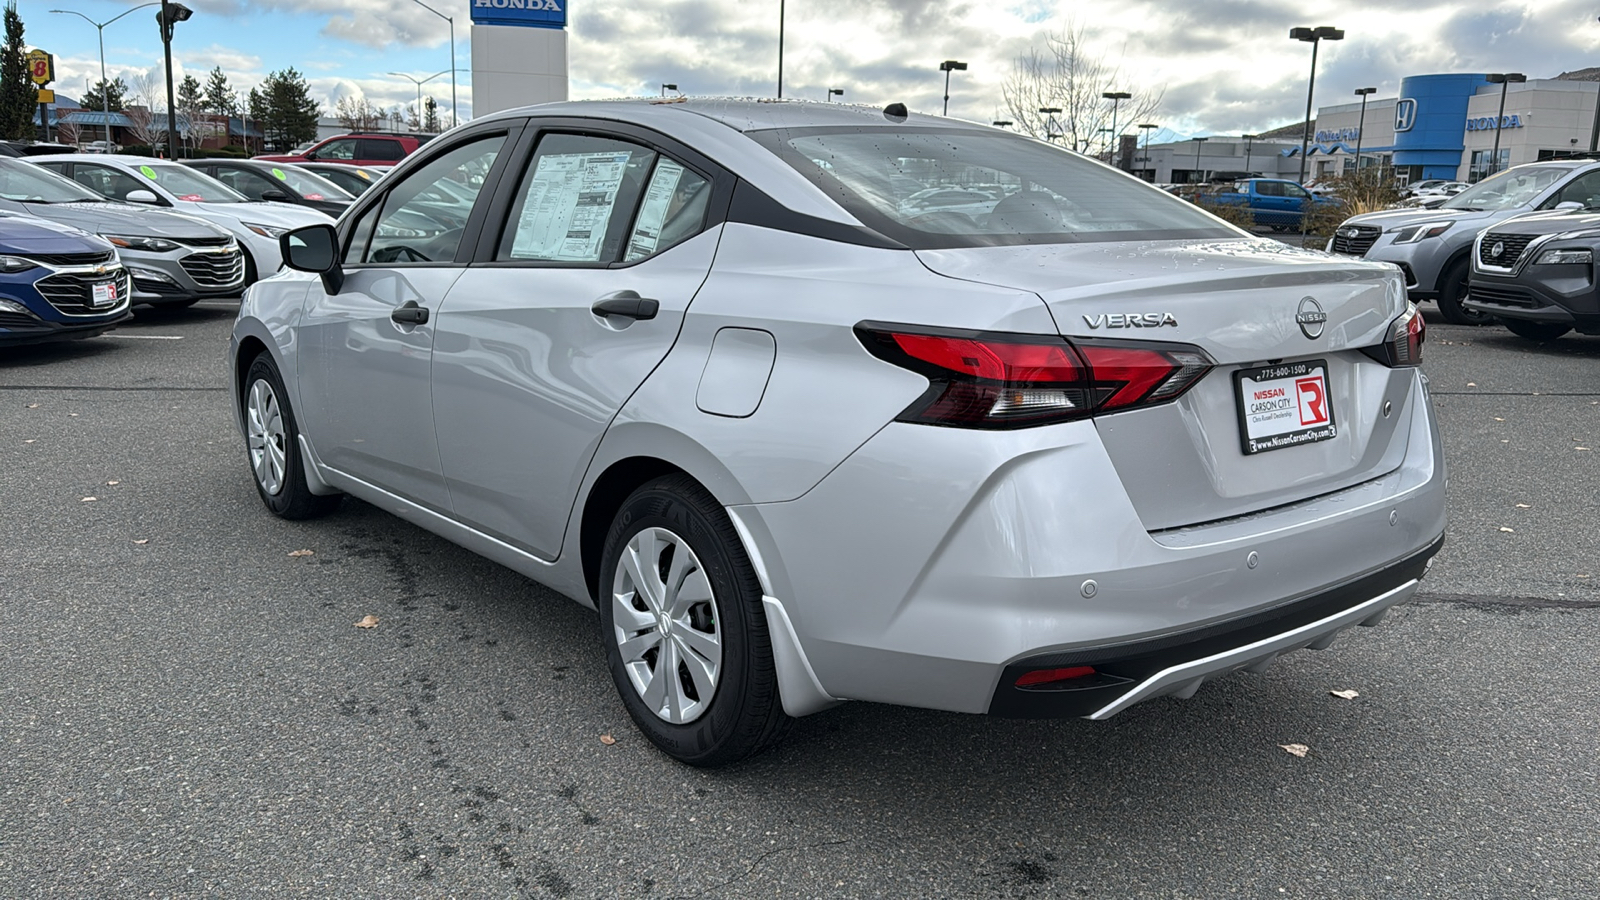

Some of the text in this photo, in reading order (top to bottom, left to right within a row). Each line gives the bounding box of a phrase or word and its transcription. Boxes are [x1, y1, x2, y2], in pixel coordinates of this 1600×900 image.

[475, 0, 562, 12] HONDA
[33, 60, 47, 78] 8
[1466, 114, 1524, 132] HONDA
[1082, 313, 1179, 330] VERSA
[1261, 364, 1306, 379] 775-600-1500
[1253, 387, 1285, 401] NISSAN
[1250, 397, 1291, 413] CARSON CITY
[1256, 429, 1329, 450] www.NissanCarsonCity.com
